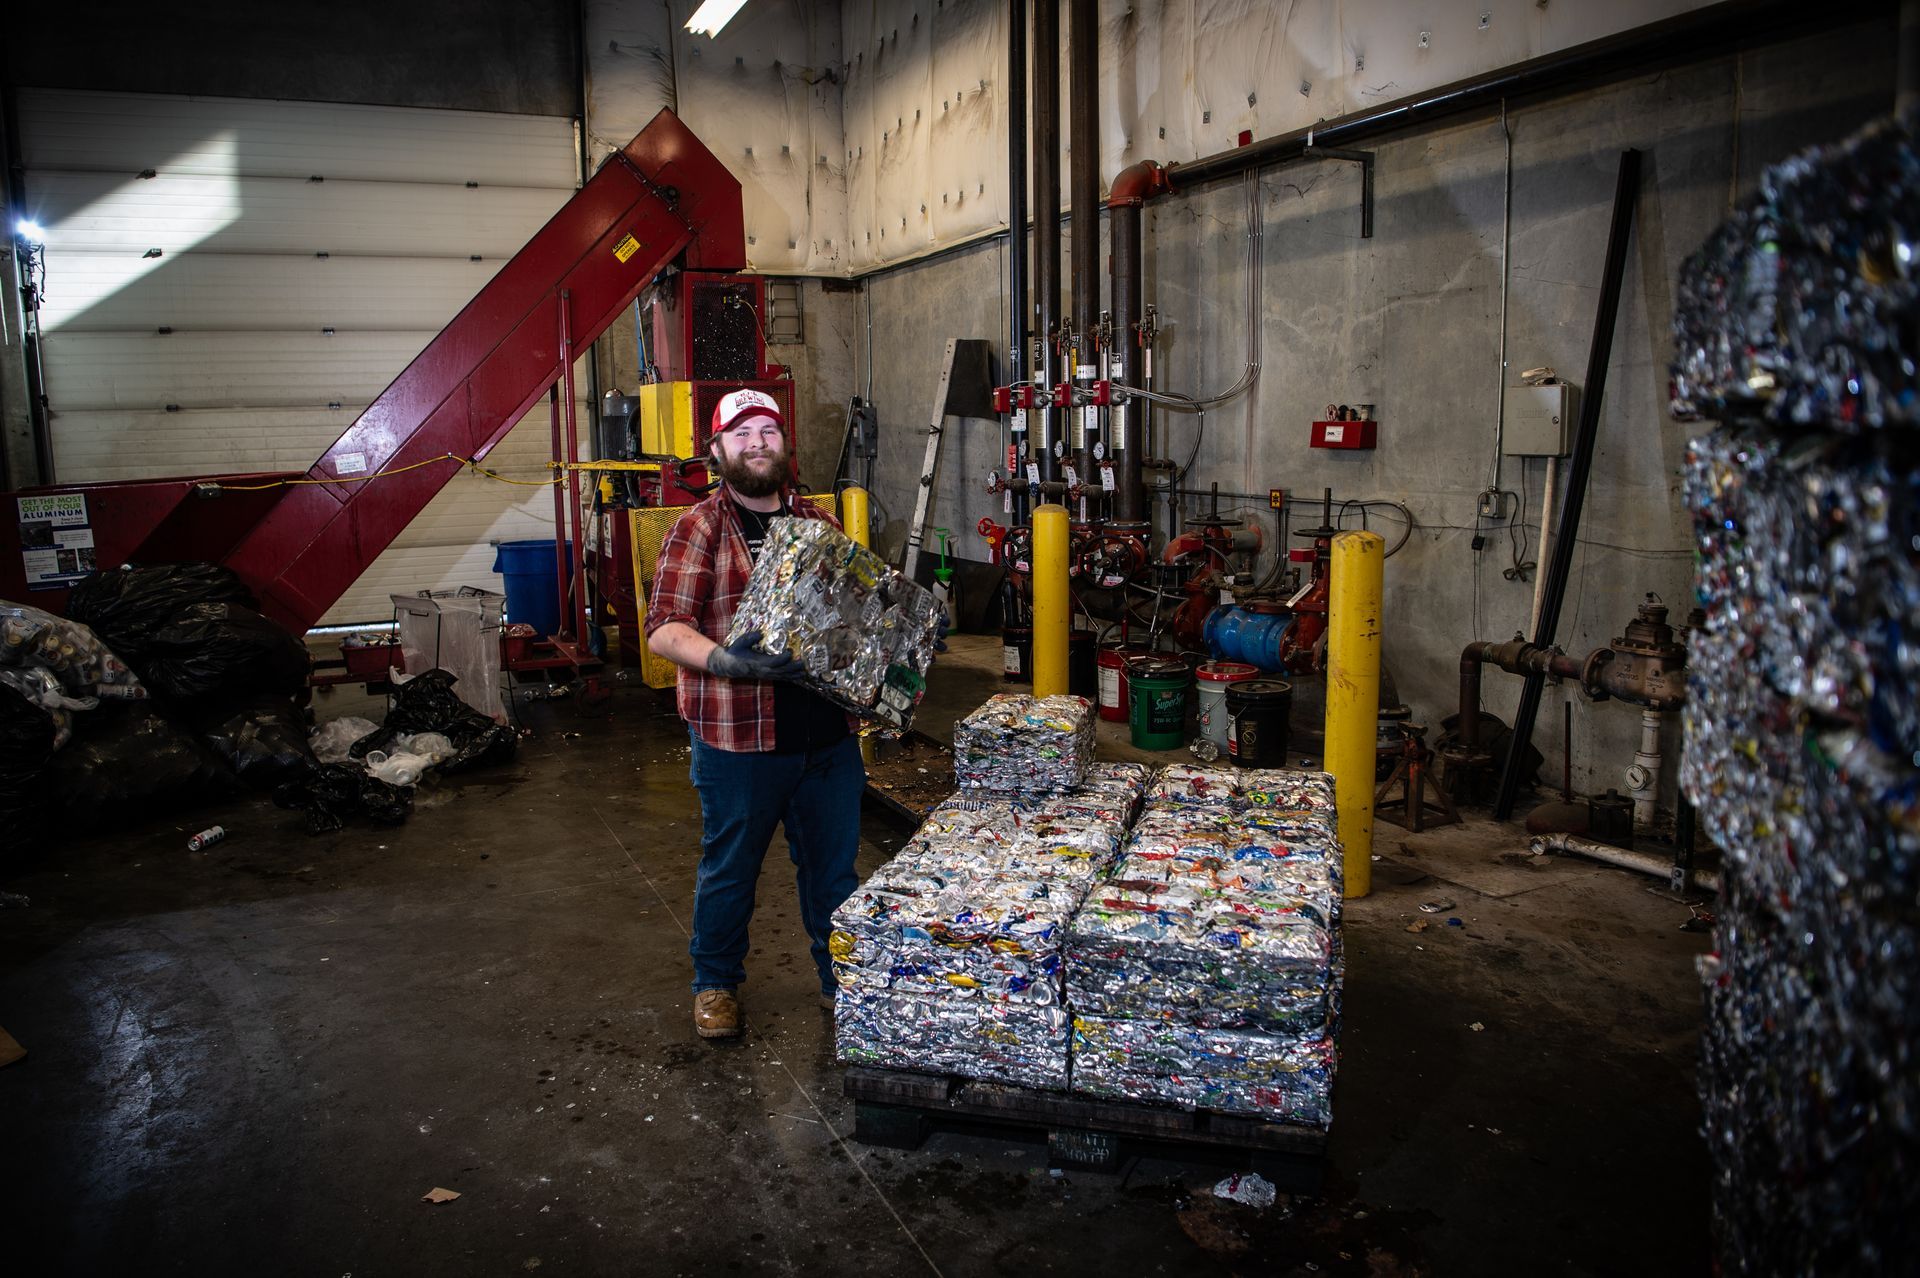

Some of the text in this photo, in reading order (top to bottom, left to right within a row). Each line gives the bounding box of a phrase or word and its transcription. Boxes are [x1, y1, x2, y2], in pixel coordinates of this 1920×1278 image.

[615, 234, 631, 249] CAUTION
[21, 496, 82, 506] GET THE MOST
[22, 505, 40, 513] OUT
[57, 502, 81, 510] YOUR
[23, 510, 83, 519] ALUMINUM
